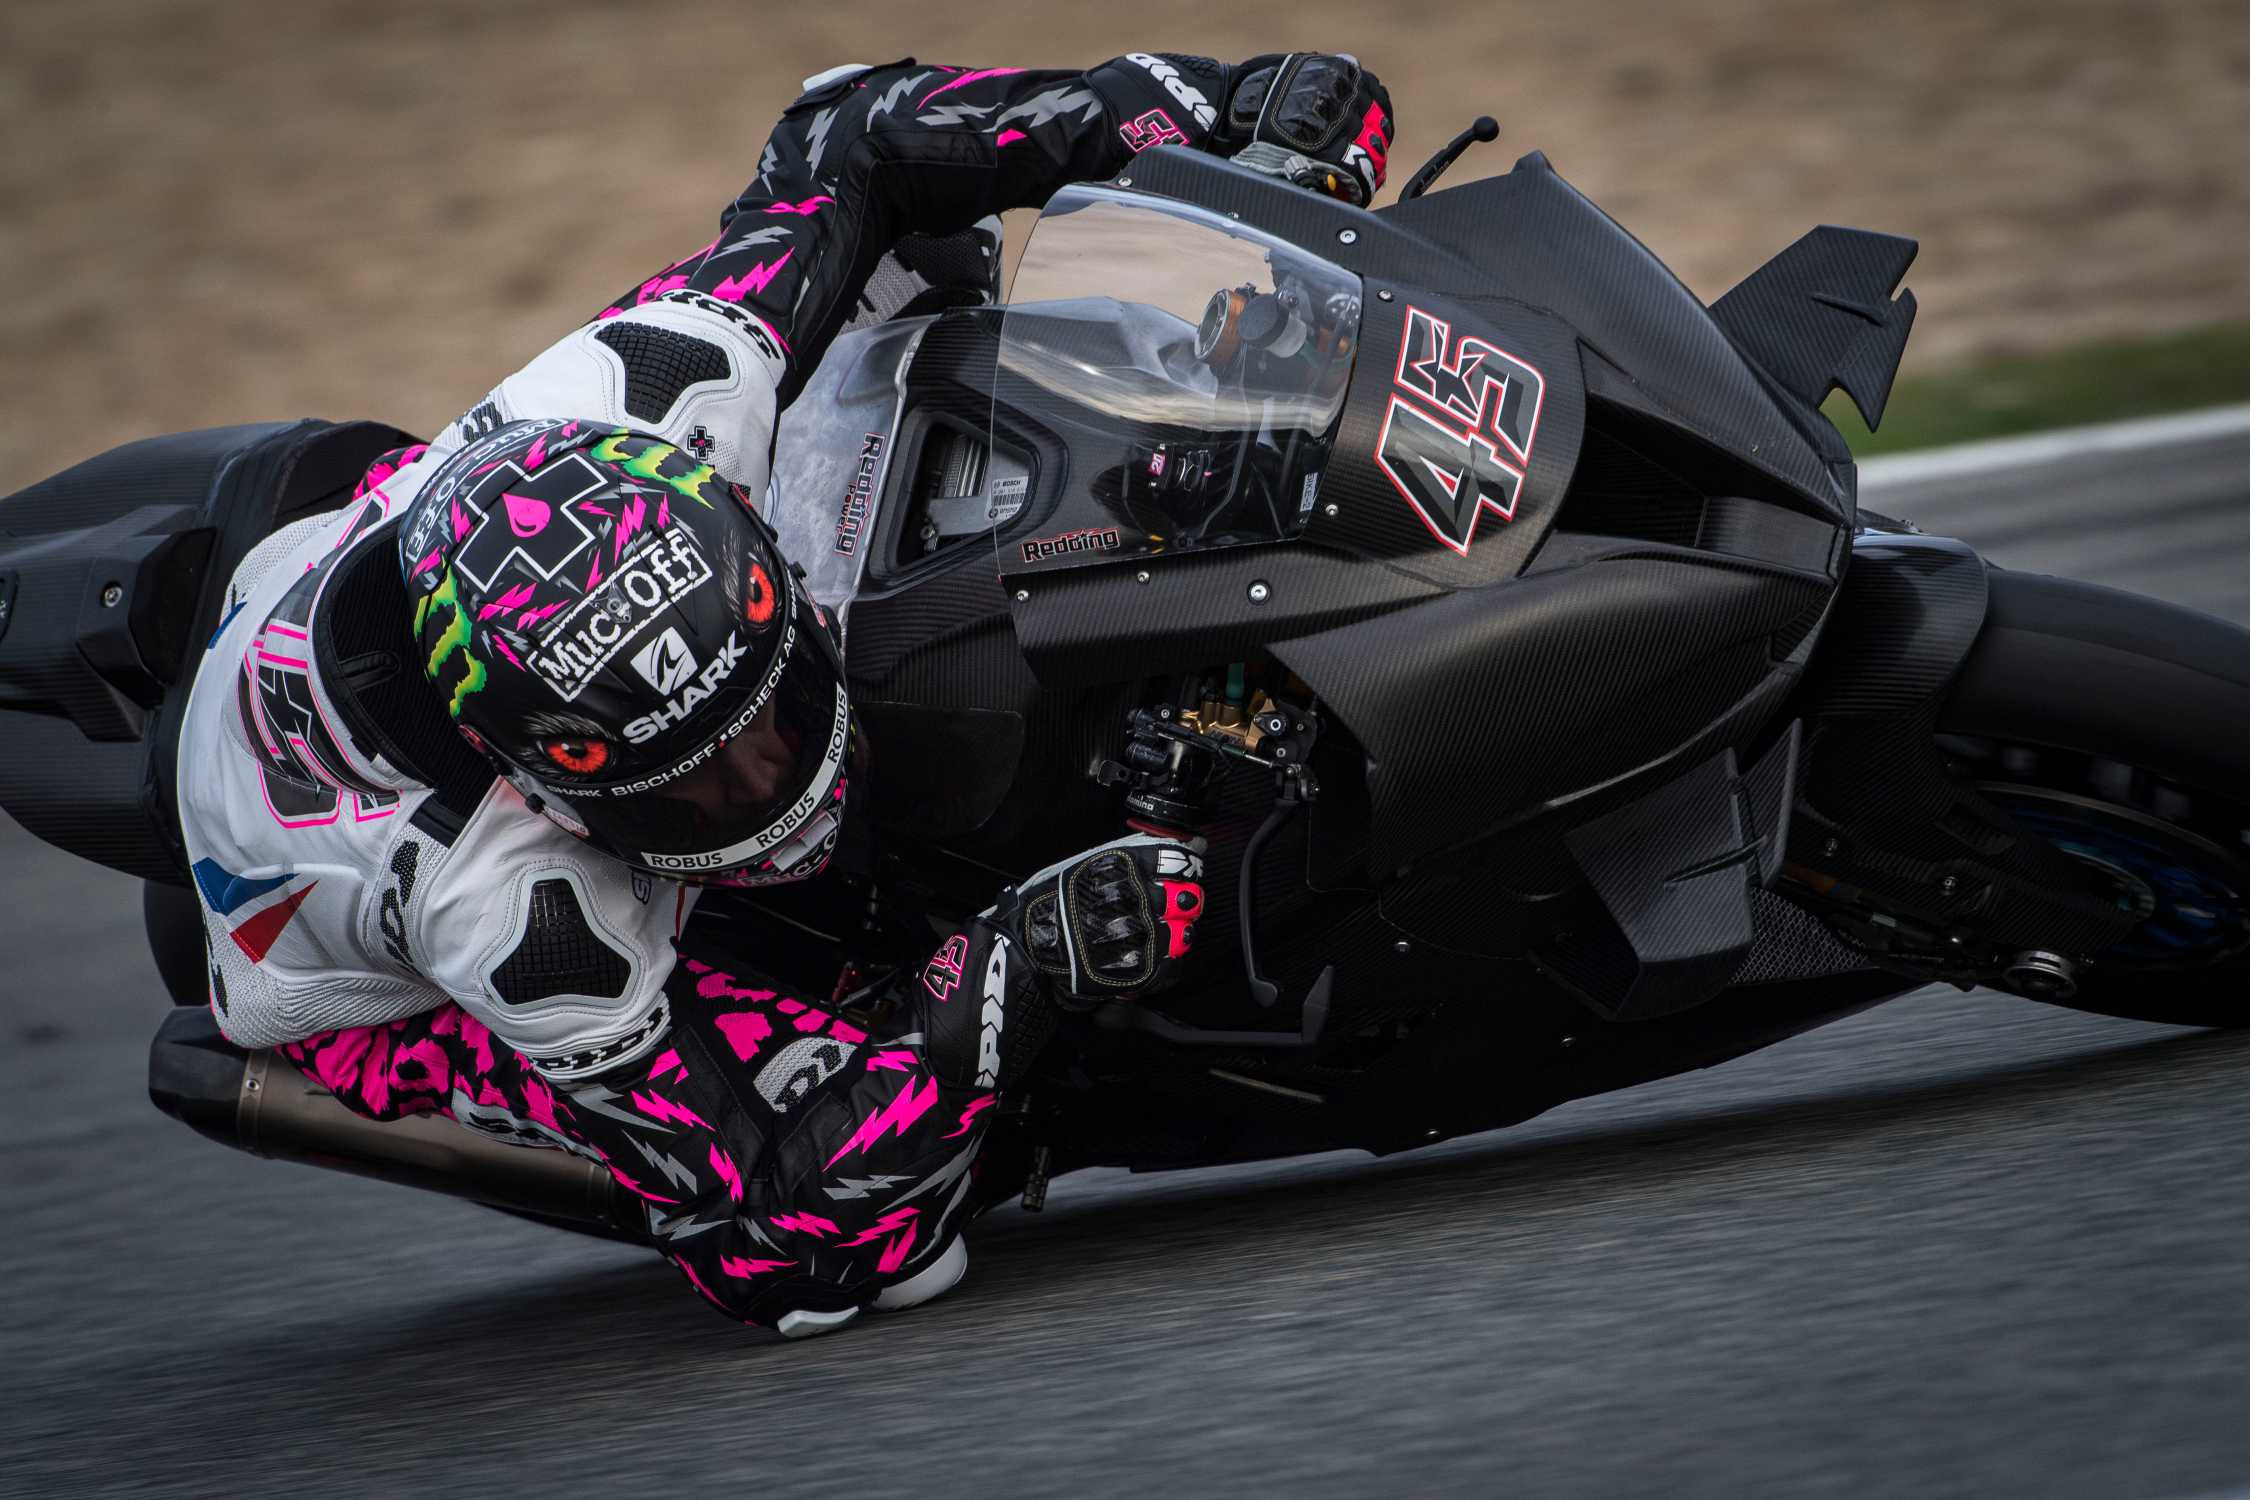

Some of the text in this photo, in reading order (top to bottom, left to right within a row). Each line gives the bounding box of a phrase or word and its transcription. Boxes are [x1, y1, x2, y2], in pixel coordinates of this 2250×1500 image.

[834, 432, 885, 556] Redding
[1376, 305, 1546, 557] 45
[1021, 529, 1120, 563] Redding
[546, 784, 602, 797] SHARK
[611, 742, 717, 796] BISCHOFF
[728, 657, 786, 738] SCHECK
[784, 625, 796, 658] AG
[623, 630, 748, 744] SHARK
[651, 692, 846, 868] ROBUS ROBUS ROBUS
